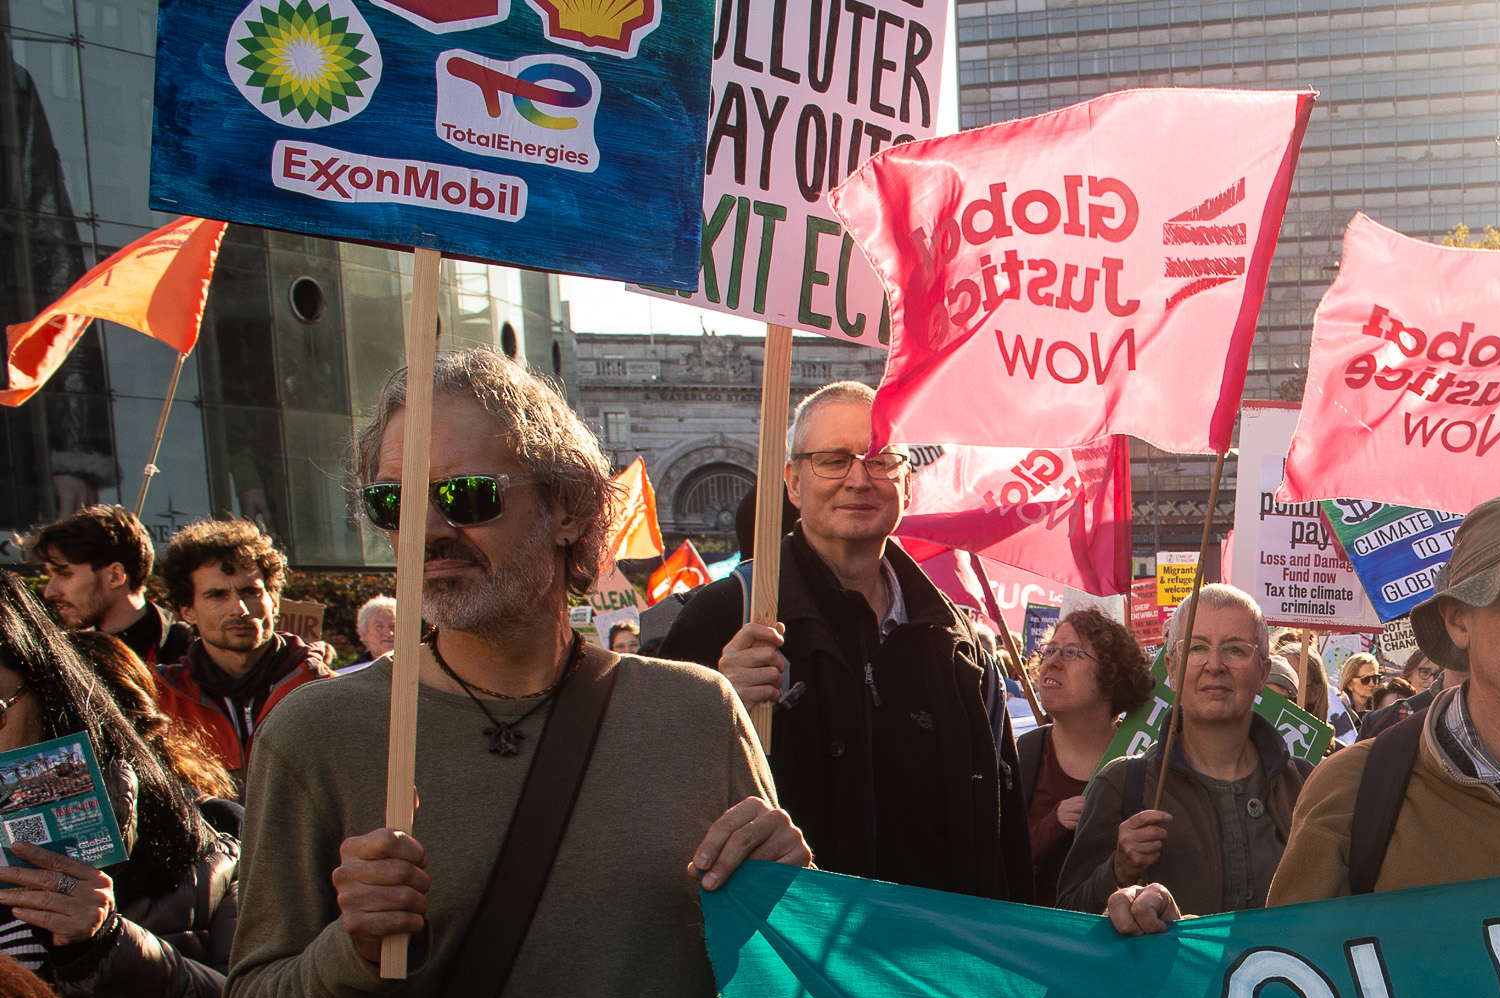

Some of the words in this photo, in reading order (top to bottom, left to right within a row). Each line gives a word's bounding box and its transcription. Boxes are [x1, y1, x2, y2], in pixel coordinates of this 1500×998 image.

[441, 122, 589, 166] TotalEnergies
[707, 80, 790, 191] AY
[282, 146, 520, 216] ExxonMobil
[676, 194, 787, 314] XIT
[798, 215, 890, 344] EC
[1289, 519, 1331, 550] pay
[1355, 512, 1432, 556] CLIMATE
[1413, 540, 1441, 559] TO
[1163, 566, 1197, 576] Migrants
[1260, 551, 1286, 566] Loss
[1289, 553, 1311, 568] and
[1313, 554, 1353, 572] Damag
[1282, 568, 1308, 583] Fund
[1313, 571, 1336, 583] now
[1164, 585, 1193, 593] welcom
[1264, 582, 1285, 598] Tax
[1288, 583, 1308, 599] the
[1310, 584, 1354, 601] climate
[590, 589, 638, 611] CLEAN
[1281, 600, 1336, 616] criminals
[1382, 630, 1416, 642] CLIMA
